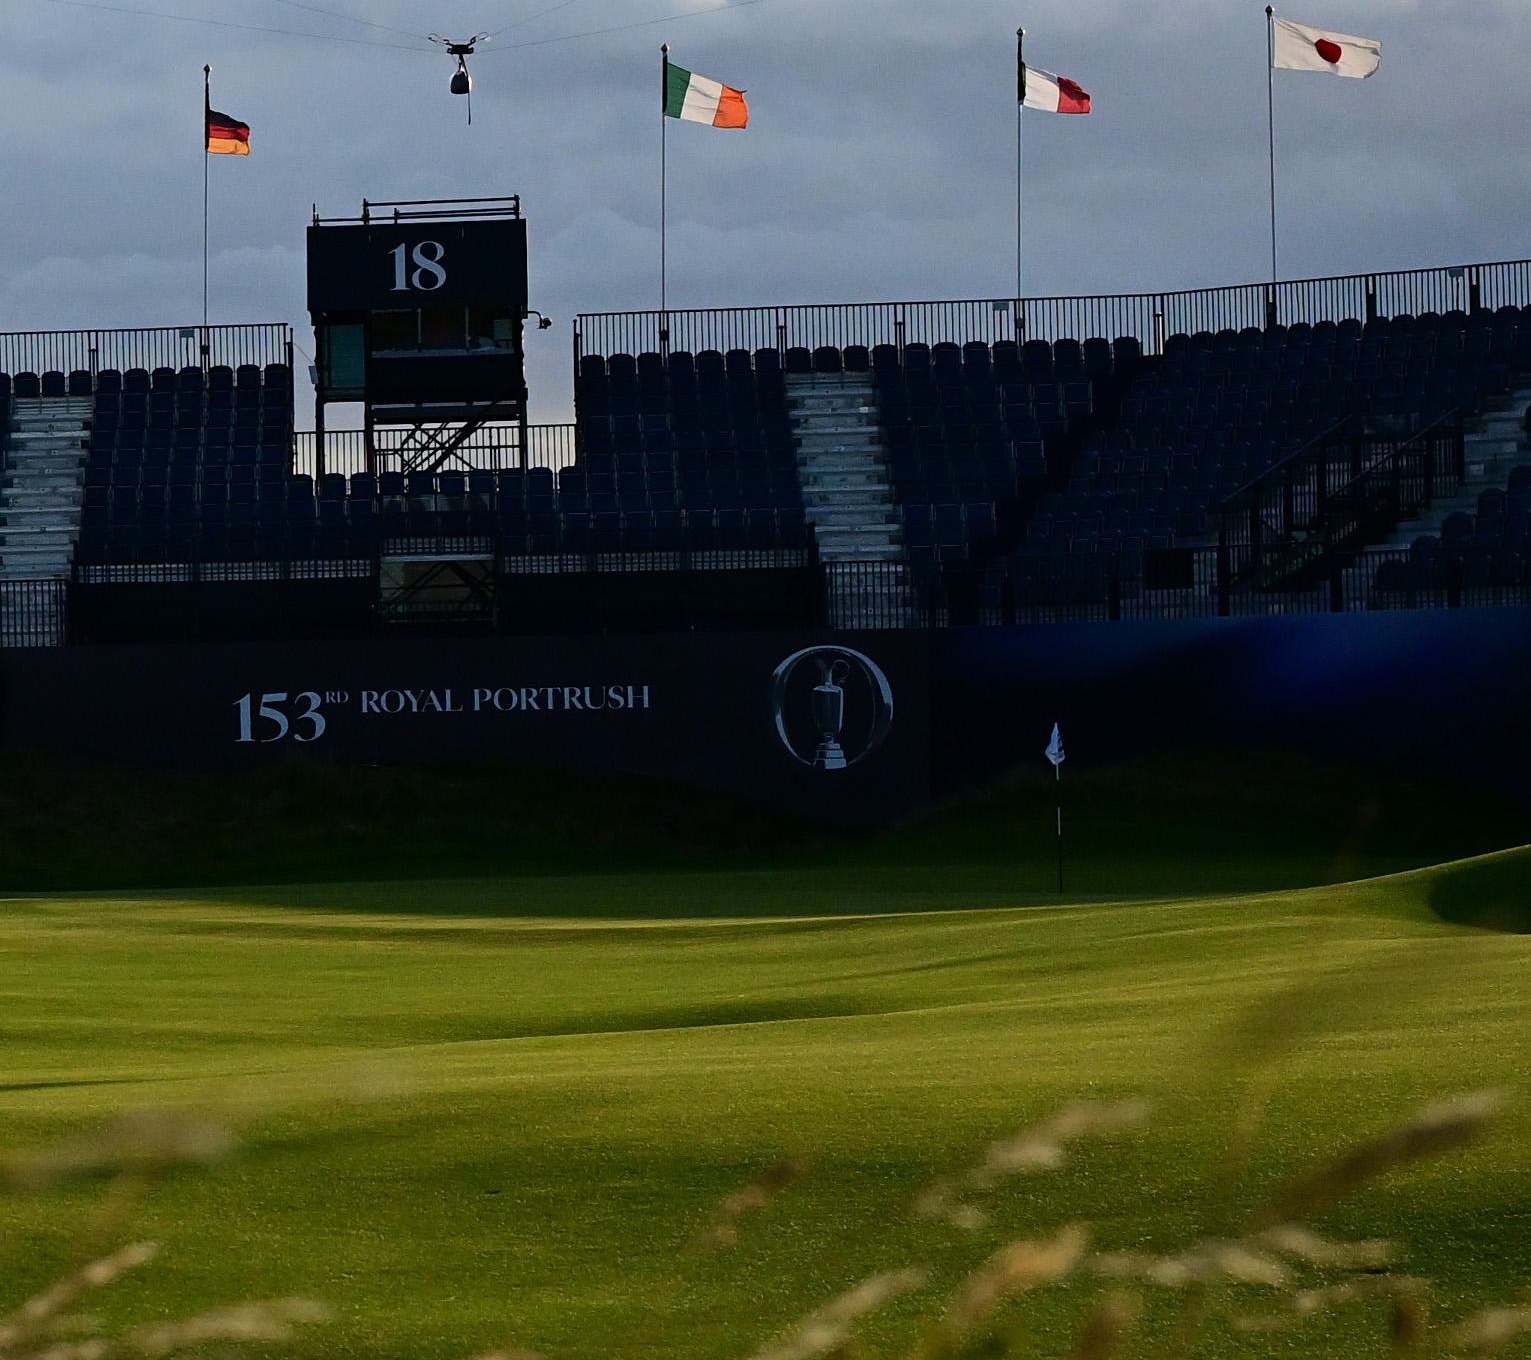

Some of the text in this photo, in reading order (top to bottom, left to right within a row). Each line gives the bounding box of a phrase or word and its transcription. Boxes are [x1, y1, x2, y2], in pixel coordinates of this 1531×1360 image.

[388, 241, 447, 291] 18
[233, 685, 650, 743] 153RD ROYAL PORTRUSH
